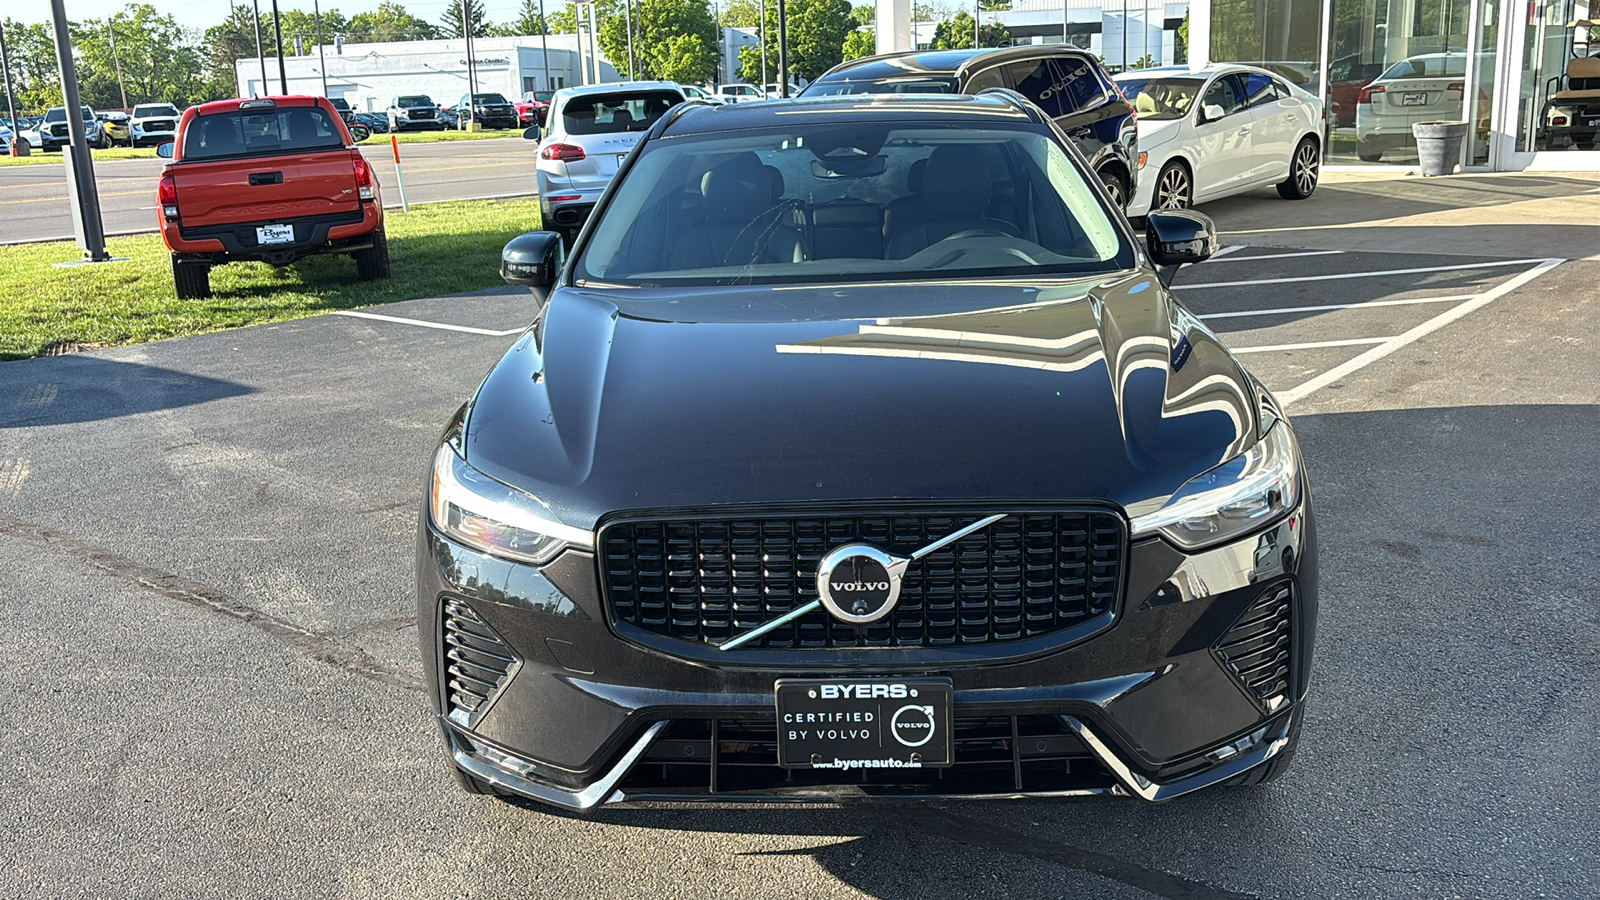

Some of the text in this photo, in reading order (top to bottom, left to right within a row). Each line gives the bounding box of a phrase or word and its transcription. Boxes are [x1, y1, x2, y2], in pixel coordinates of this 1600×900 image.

[830, 581, 889, 592] VOLVO
[820, 684, 908, 699] BYERS
[783, 712, 874, 724] CERTIFIED
[896, 721, 930, 729] VOLVO
[788, 729, 871, 740] BY VOLVO
[812, 757, 922, 770] www.byersauto.com
